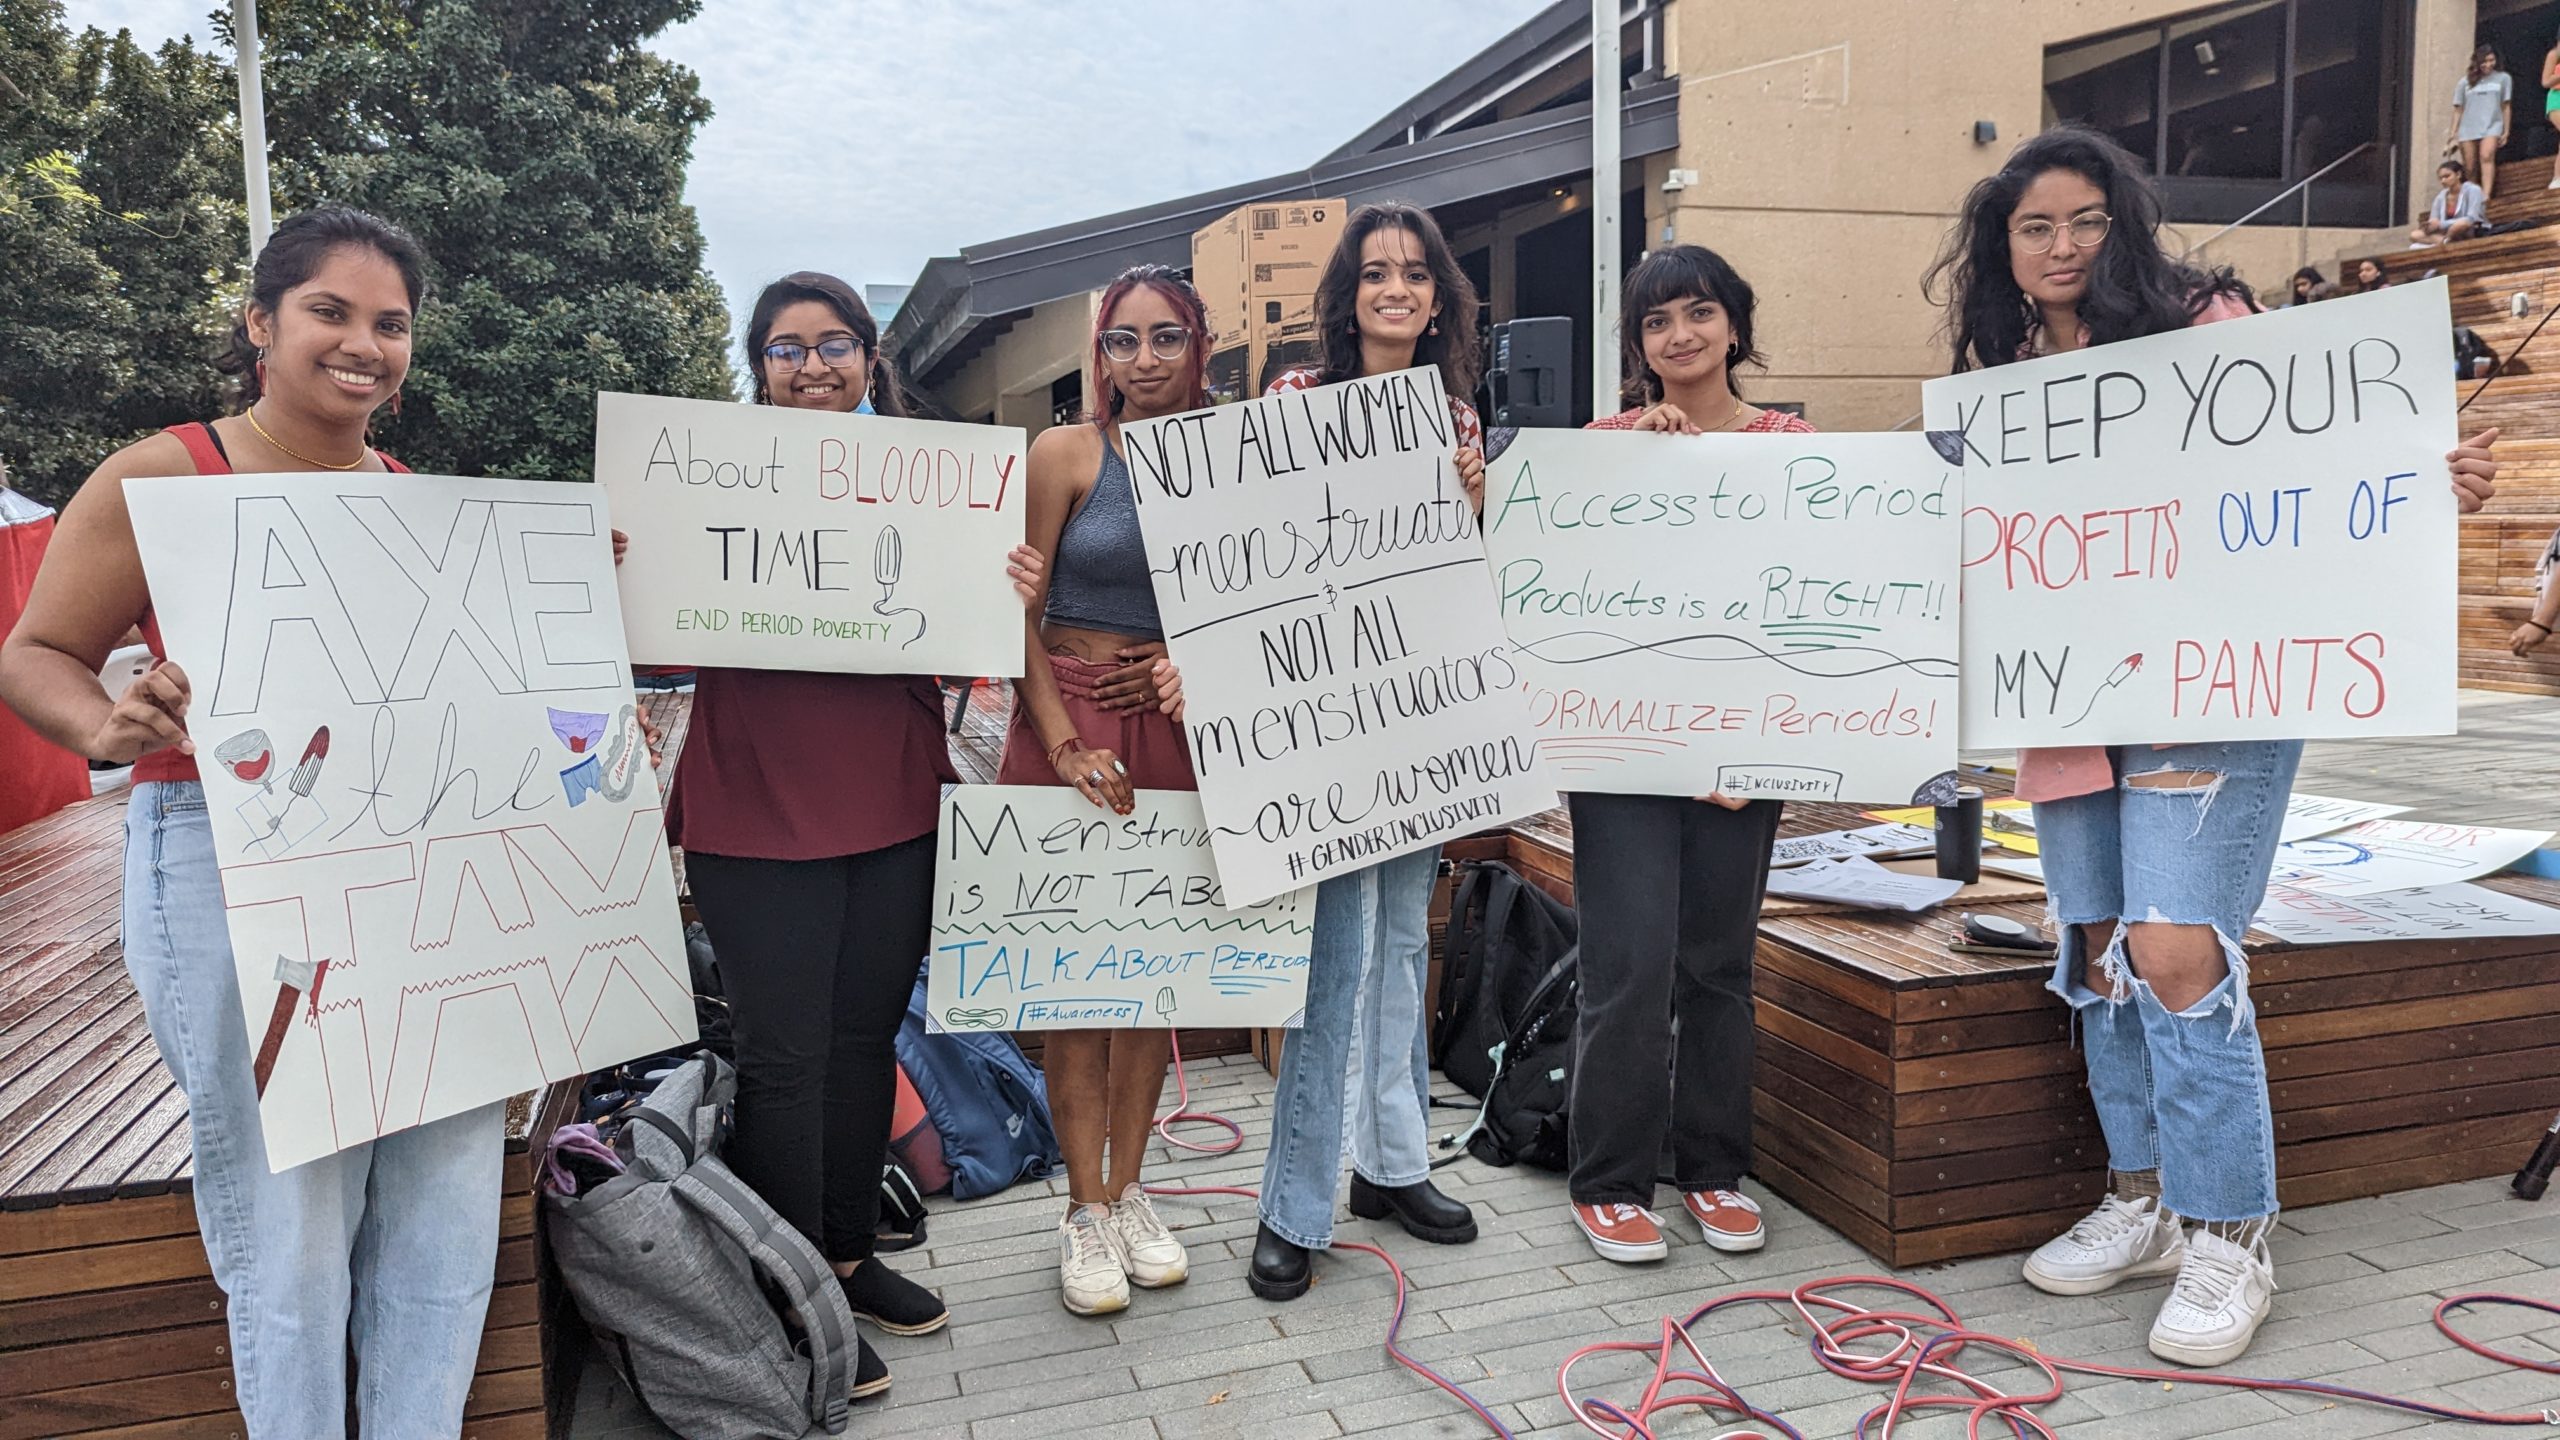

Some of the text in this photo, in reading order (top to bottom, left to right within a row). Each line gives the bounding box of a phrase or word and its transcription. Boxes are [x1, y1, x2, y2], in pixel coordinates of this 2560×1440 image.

[1124, 375, 1449, 505] NOT ALL WOMEN
[1957, 337, 2419, 468] KEEP YOUR
[645, 427, 1016, 513] About BLOODLY
[1492, 456, 1949, 535] Access to Period
[705, 526, 850, 591] TIME
[1150, 457, 1479, 602] menstruate
[1961, 473, 2418, 591] PROFITS OUT OF
[211, 495, 621, 718] AXE
[676, 609, 892, 643] END PERIOD POVERTY
[1499, 558, 1946, 621] Products is a RIGHT!!
[1260, 594, 1419, 688] NOT ALL
[1995, 633, 2388, 719] MY PANTS
[1192, 646, 1517, 777] menstruators
[1523, 681, 1938, 739] ORMALIZE Periods!
[330, 702, 554, 843] the
[1211, 734, 1541, 844] are women
[952, 800, 1215, 862] Menstrua
[948, 880, 984, 917] is
[1015, 872, 1095, 912] NOT
[220, 808, 696, 1152] TAX
[938, 940, 1080, 1000] TALK
[1085, 944, 1206, 982] ABOUT
[1027, 1003, 1133, 1024] #Awareness
